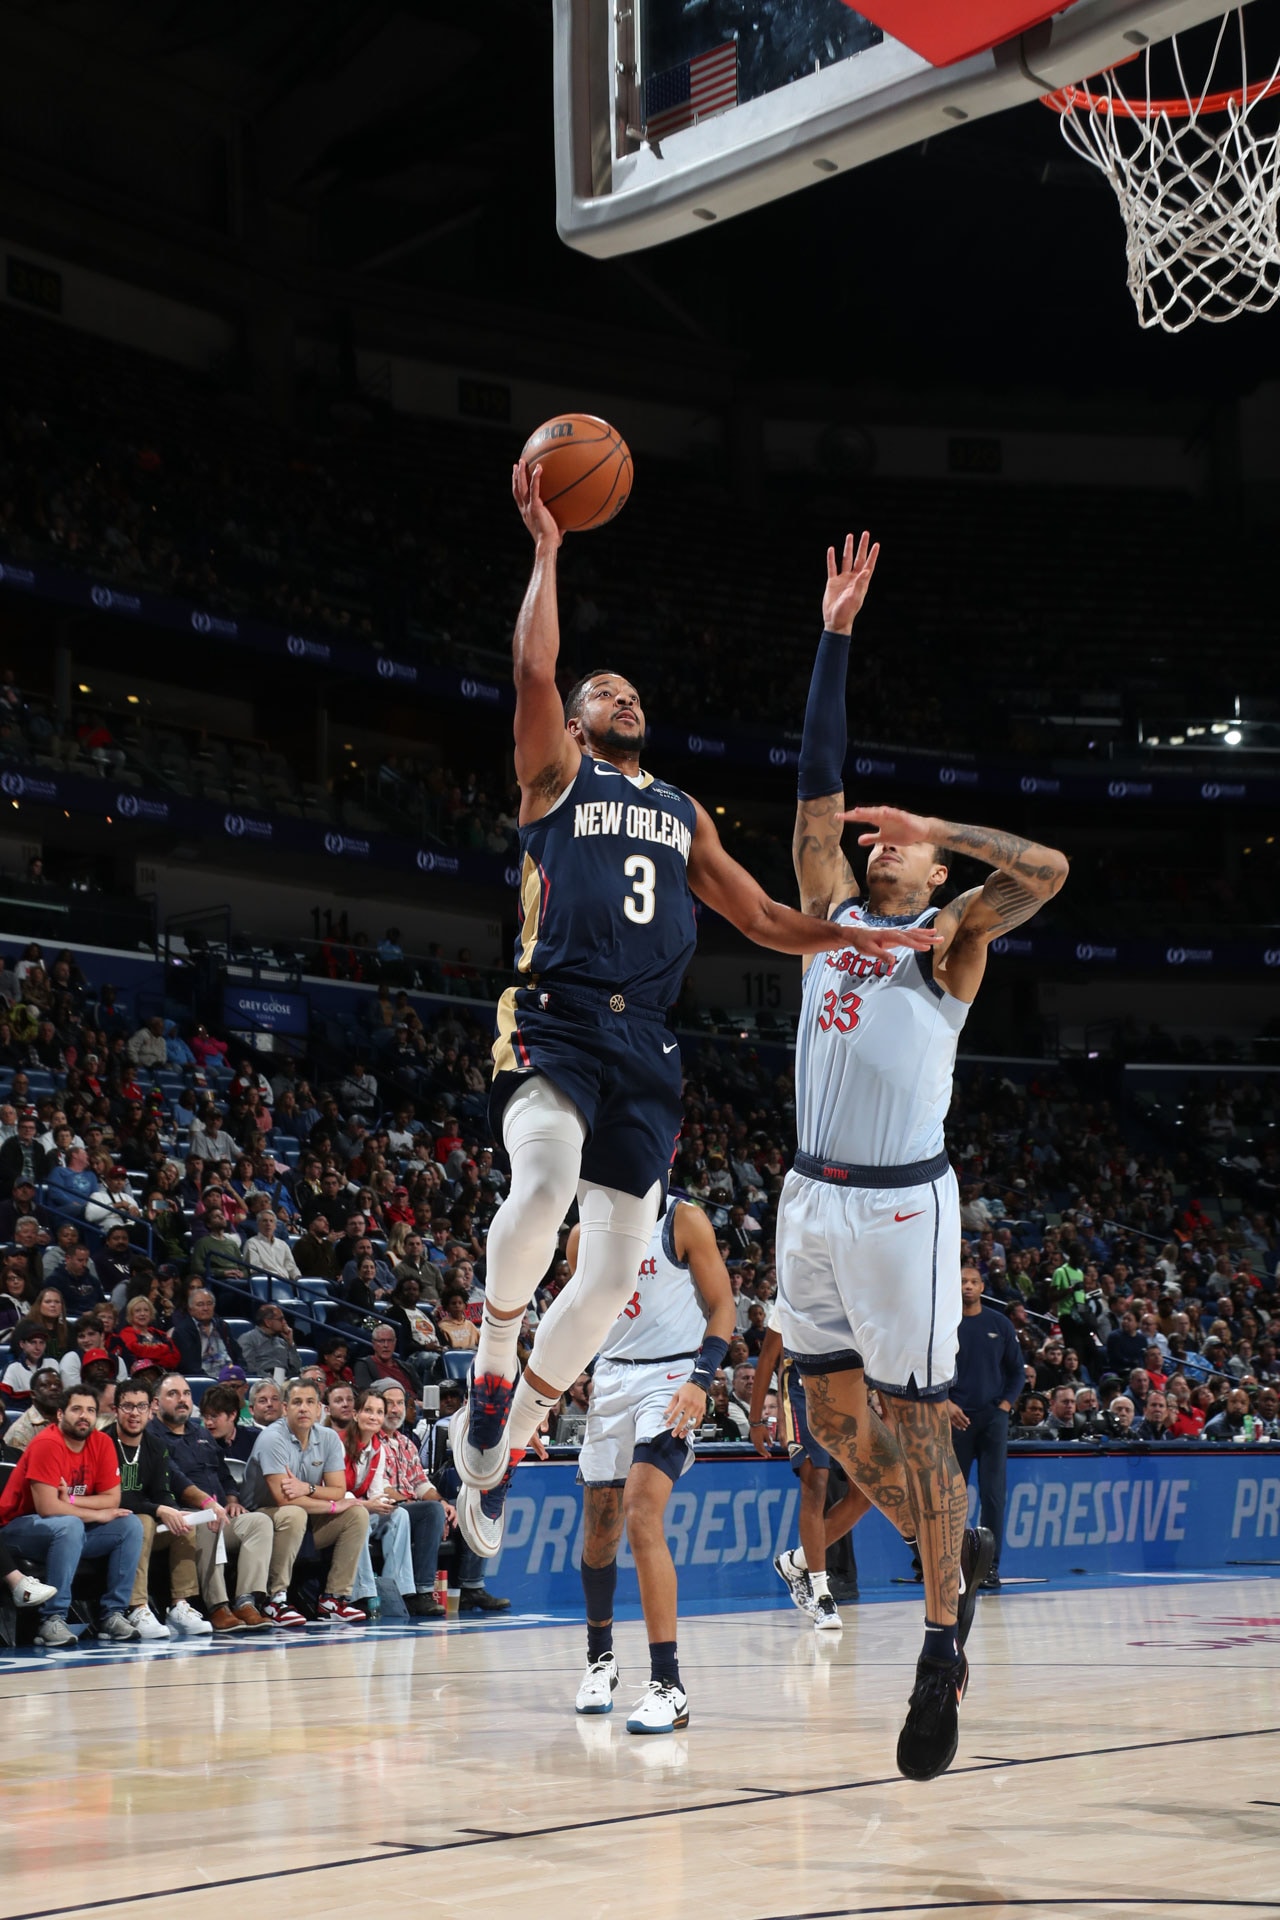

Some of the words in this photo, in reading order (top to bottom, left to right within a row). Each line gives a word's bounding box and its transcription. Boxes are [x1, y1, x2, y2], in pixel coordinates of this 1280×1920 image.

[574, 801, 624, 838] NEW
[626, 805, 692, 867] ORLEAN
[624, 854, 656, 925] 3
[239, 999, 260, 1011] GREY
[262, 1002, 291, 1015] GOOSE
[742, 972, 780, 1009] 115
[818, 989, 863, 1034] 33
